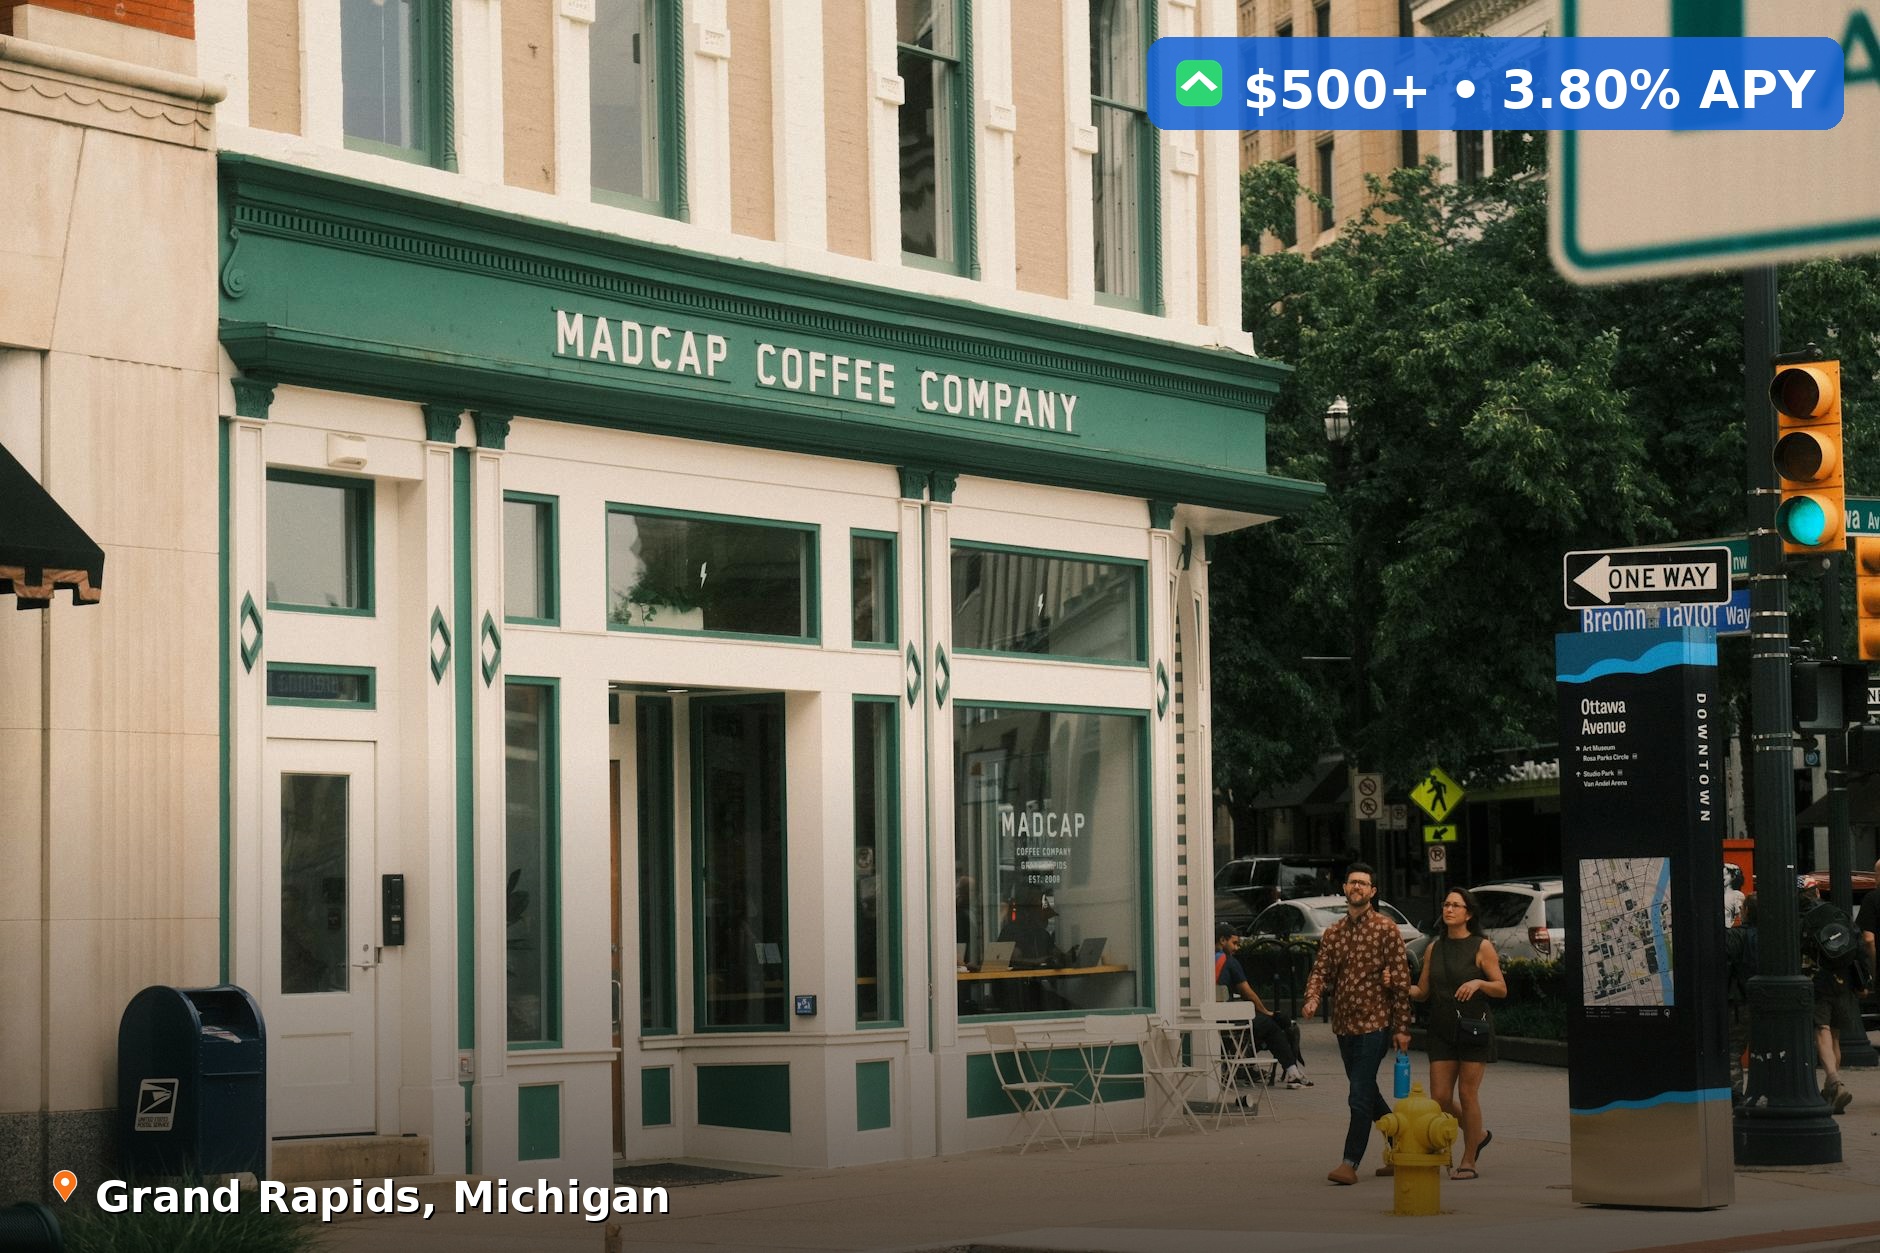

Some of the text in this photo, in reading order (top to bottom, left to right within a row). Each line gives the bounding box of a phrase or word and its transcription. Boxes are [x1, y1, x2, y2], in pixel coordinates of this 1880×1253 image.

[557, 310, 1077, 432] MADCAP COFFEE COMPANY
[1733, 556, 1748, 570] nw
[1609, 566, 1710, 589] ONE WAY
[1584, 608, 1647, 633] Breonn
[1726, 606, 1750, 629] Way
[1581, 698, 1626, 715] Ottawa
[1581, 718, 1626, 735] Avenue
[1696, 693, 1711, 821] DOWNTOWN
[1002, 812, 1085, 837] MADCAP
[1016, 847, 1071, 856] COFFEE COMPANY
[1028, 875, 1043, 884] EST.
